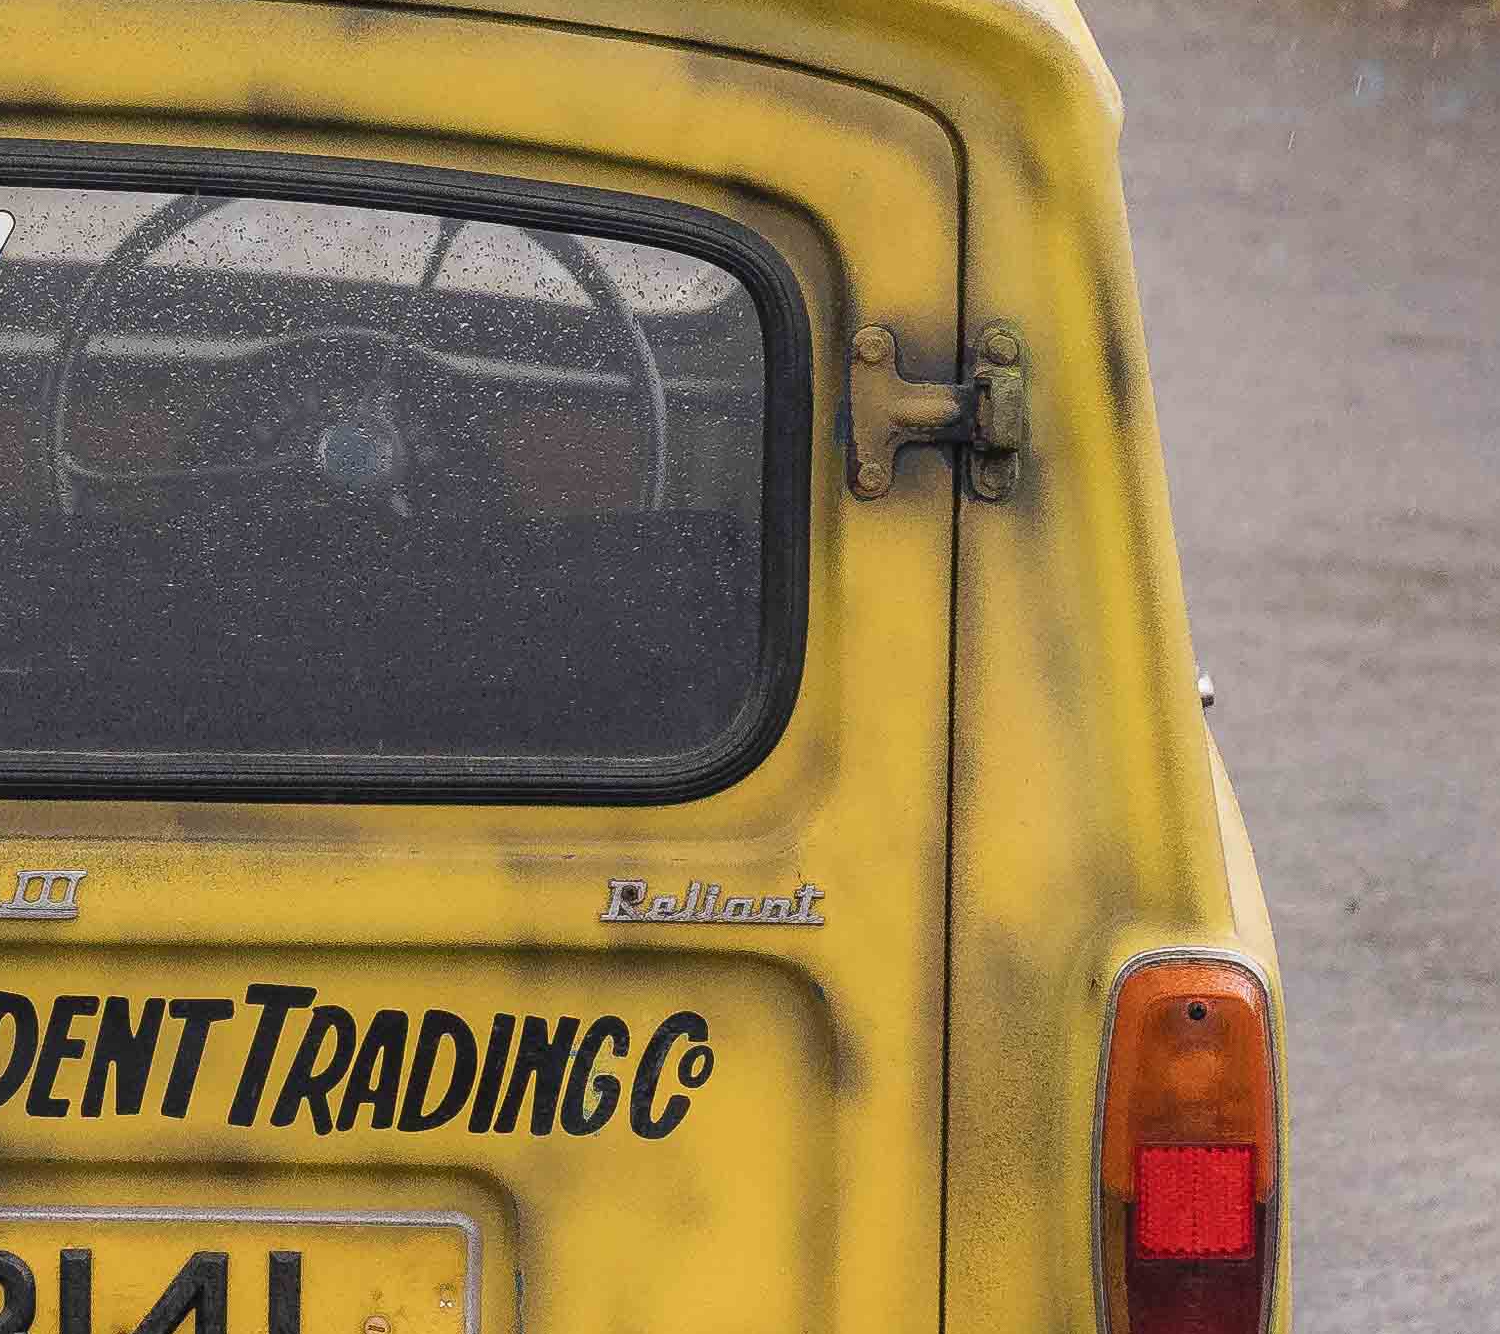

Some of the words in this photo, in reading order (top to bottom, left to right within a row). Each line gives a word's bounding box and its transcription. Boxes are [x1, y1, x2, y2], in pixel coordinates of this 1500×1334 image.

[10, 868, 88, 910] III
[602, 878, 825, 926] Reliant
[228, 984, 631, 1137] TRADING
